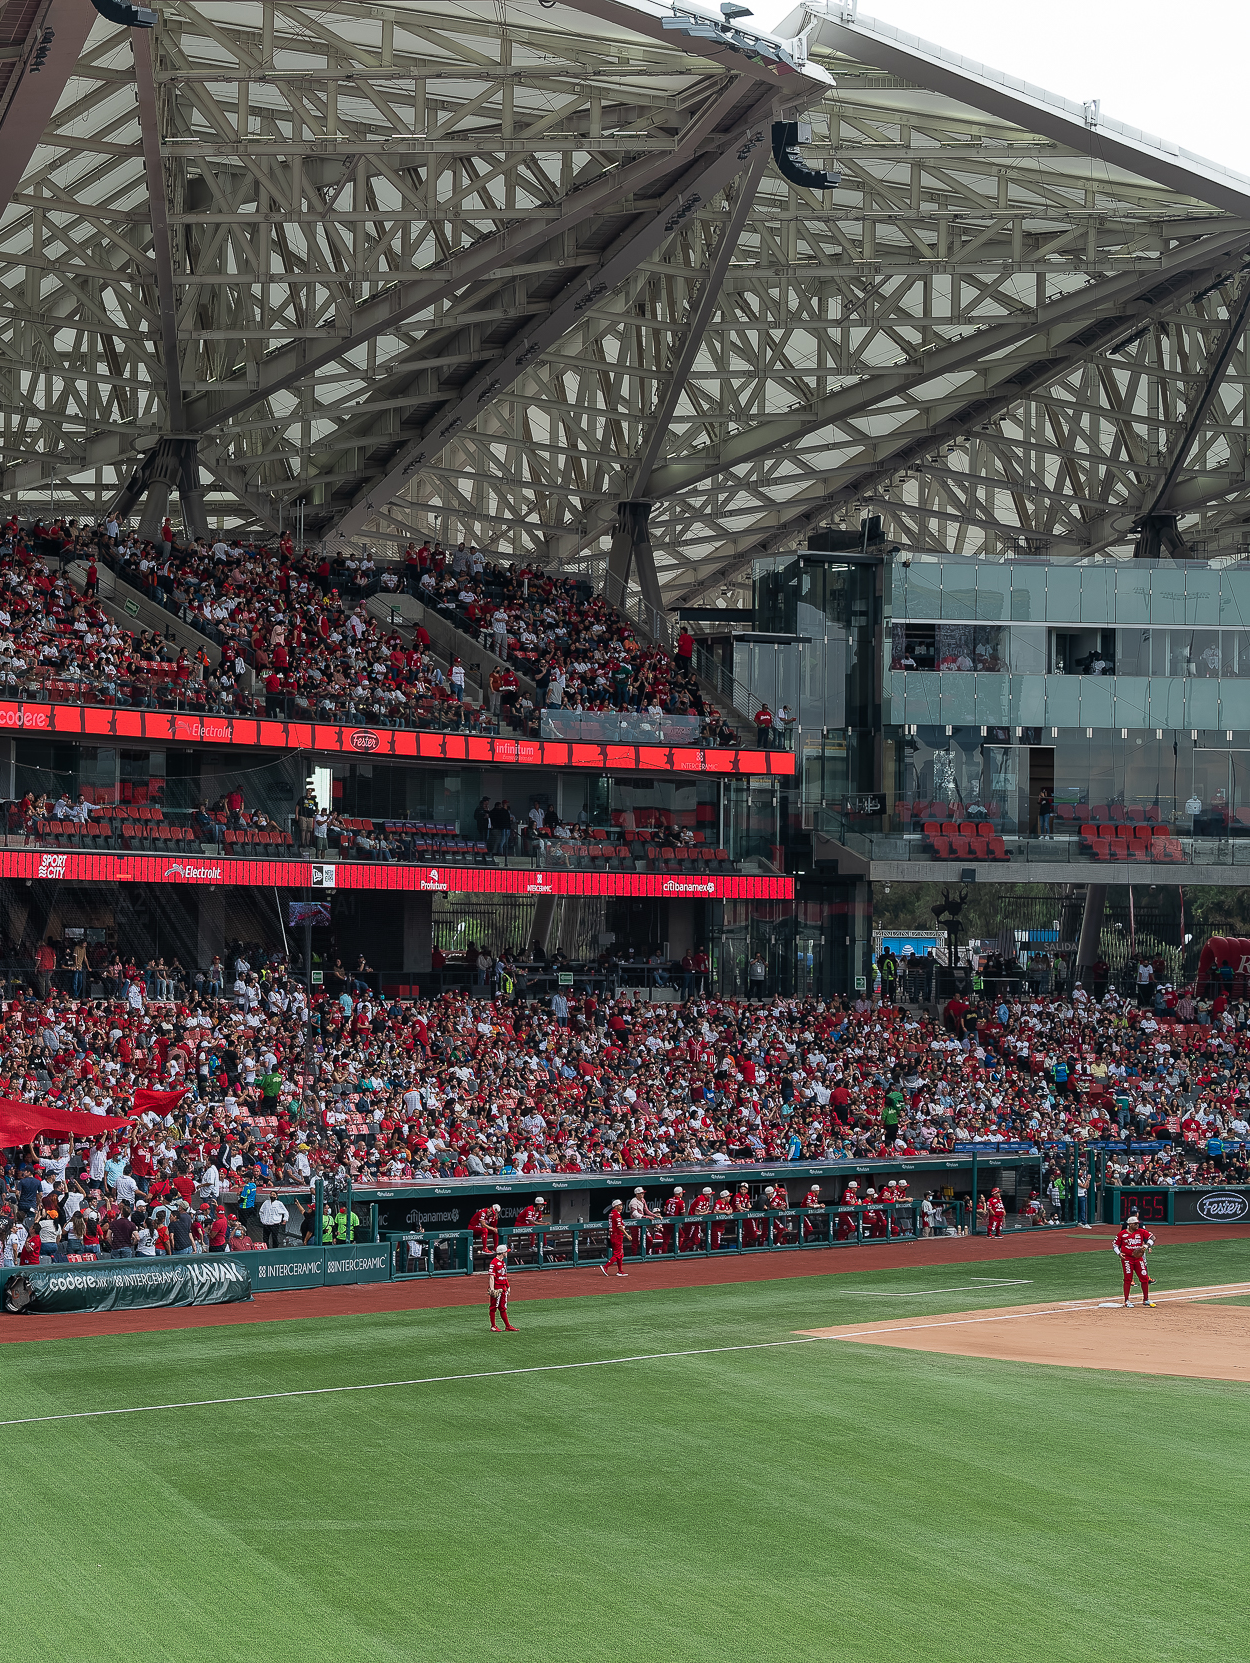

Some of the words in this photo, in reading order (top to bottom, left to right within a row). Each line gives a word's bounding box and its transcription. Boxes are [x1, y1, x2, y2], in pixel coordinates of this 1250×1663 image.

[192, 724, 232, 738] Electrolit
[352, 734, 377, 748] Fester
[496, 742, 534, 755] infinitum
[680, 762, 717, 770] INTERCERAMIC
[42, 854, 67, 867] SPORT
[48, 866, 65, 878] CITY
[185, 865, 221, 879] Electrolit
[420, 880, 447, 890] Profuturo
[664, 880, 708, 892] citibanamex
[1044, 942, 1078, 951] SALIDA
[1203, 1197, 1242, 1214] Fester
[267, 1261, 321, 1277] INTERCERAMIC
[334, 1257, 385, 1273] INTERCERAMIC
[123, 1269, 184, 1287] INTERCERAMIC
